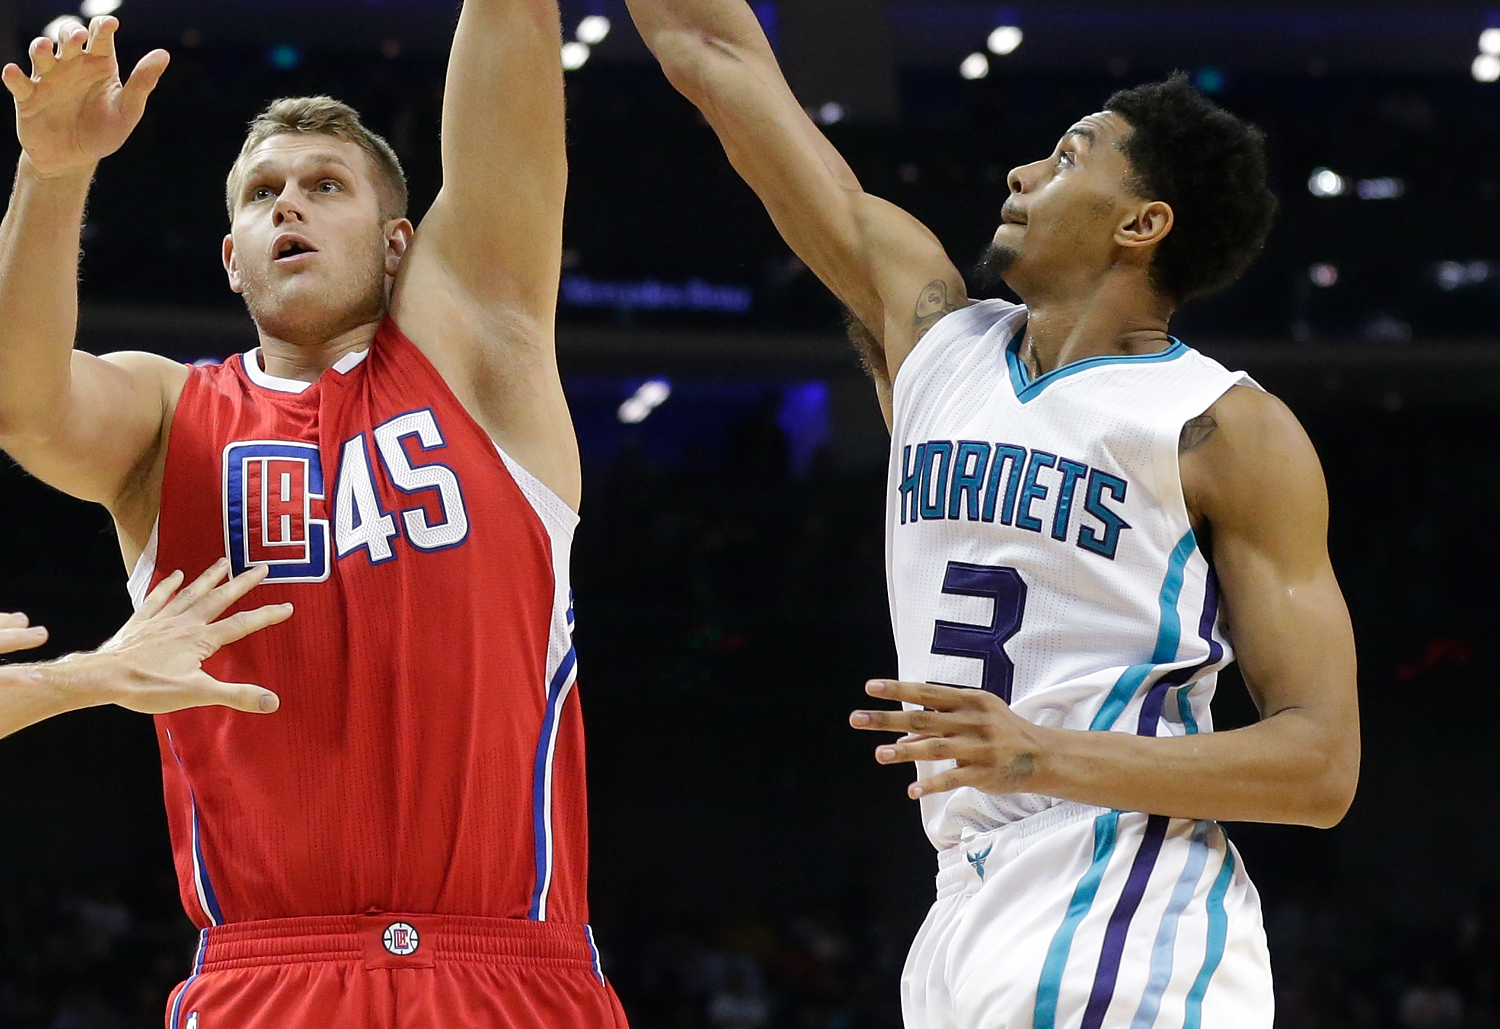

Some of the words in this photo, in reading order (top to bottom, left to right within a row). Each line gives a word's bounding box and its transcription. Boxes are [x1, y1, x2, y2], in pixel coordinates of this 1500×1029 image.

[333, 407, 470, 567] 45
[898, 440, 1133, 561] HORNETS
[924, 560, 1028, 713] 3
